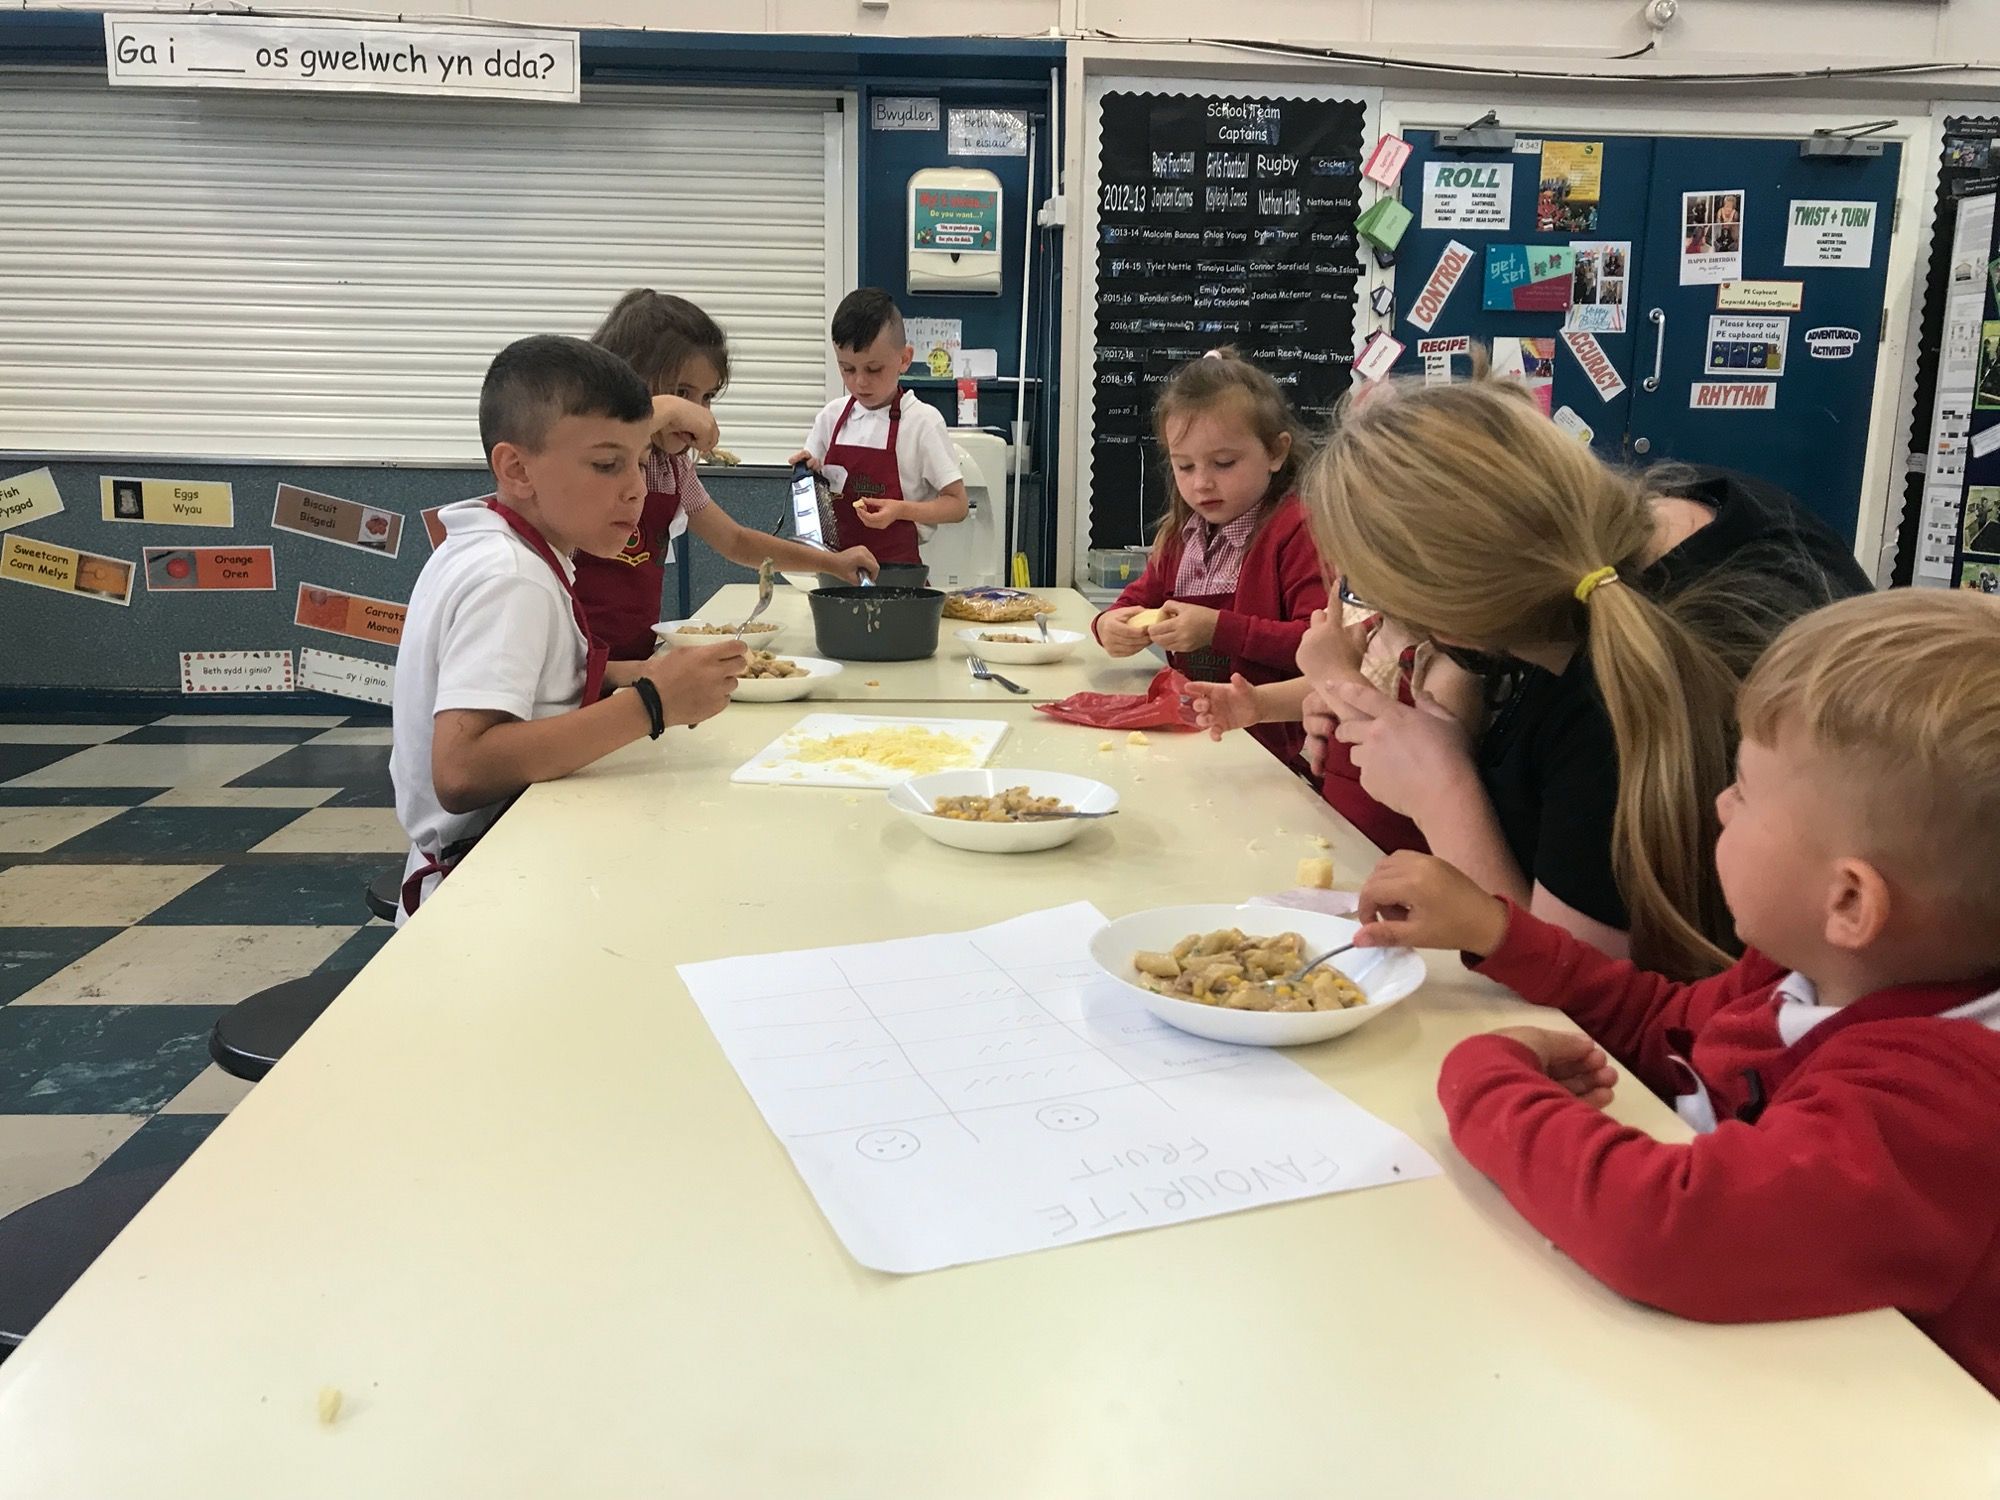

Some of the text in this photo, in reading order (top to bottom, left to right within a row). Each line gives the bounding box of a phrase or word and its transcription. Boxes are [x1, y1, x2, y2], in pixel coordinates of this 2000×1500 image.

[117, 36, 556, 83] Ga i os gwelwch yn dda?
[876, 104, 934, 127] Bwydlen
[1206, 102, 1247, 118] School
[1218, 124, 1268, 143] Captains
[1222, 152, 1249, 178] Football
[1257, 153, 1299, 176] Rugby
[1318, 160, 1346, 168] Cricket
[1435, 167, 1500, 188] ROLL
[1104, 184, 1147, 212] 2012-13
[1258, 188, 1301, 215] Nathan Hills
[1307, 198, 1352, 207] Nathan Hills
[941, 211, 954, 219] you
[1794, 206, 1830, 226] TWIST
[1840, 207, 1871, 227] TURN
[1110, 228, 1139, 237] 2013-14
[1142, 230, 1173, 238] Malcolm
[1204, 230, 1247, 241] Chloe Young
[1311, 232, 1333, 241] Ethan
[1112, 261, 1192, 272] 2014-15 Tyler Nettle
[1250, 262, 1275, 271] Connor
[1491, 253, 1516, 279] get
[1502, 264, 1525, 284] set
[1200, 285, 1245, 296] Emily Dennis
[1415, 247, 1469, 323] CONTROL
[1103, 294, 1132, 303] 2015-16
[1171, 294, 1193, 302] Smith
[1251, 291, 1277, 300] Joshua
[1110, 322, 1139, 330] 2016-17
[1720, 319, 1744, 327] Please
[1746, 320, 1764, 329] keep
[1728, 331, 1763, 340] cupboard
[1765, 331, 1781, 340] tidy
[1807, 329, 1859, 341] ADVENTUROUS
[1420, 338, 1468, 353] RECIPE
[1812, 345, 1851, 356] ACTIVITIES
[1105, 349, 1134, 358] 2017-18
[1253, 350, 1276, 358] Adam
[1303, 352, 1354, 363] Mason Thyer
[1101, 374, 1133, 383] 2018-19
[1144, 373, 1168, 382] Marco
[1272, 375, 1297, 383] omas
[1697, 385, 1769, 406] RHYTHM
[174, 488, 199, 501] Eggs
[173, 503, 202, 516] Wyau
[303, 497, 338, 514] Biscuit
[300, 511, 336, 528] Bisgedi
[13, 544, 69, 566] Sweetcorn
[214, 554, 254, 566] Orange
[9, 558, 69, 581] Corn Melys
[222, 568, 249, 579] Oren
[364, 606, 406, 621] Carrots
[366, 620, 399, 635] Moron
[202, 666, 222, 675] Beth
[223, 666, 243, 676] sydd
[249, 666, 272, 679] ginio?
[345, 672, 357, 684] sy
[364, 676, 389, 688] ginio.
[1070, 1137, 1210, 1181] FRUIT
[1035, 1150, 1341, 1237] FAVOURITE
